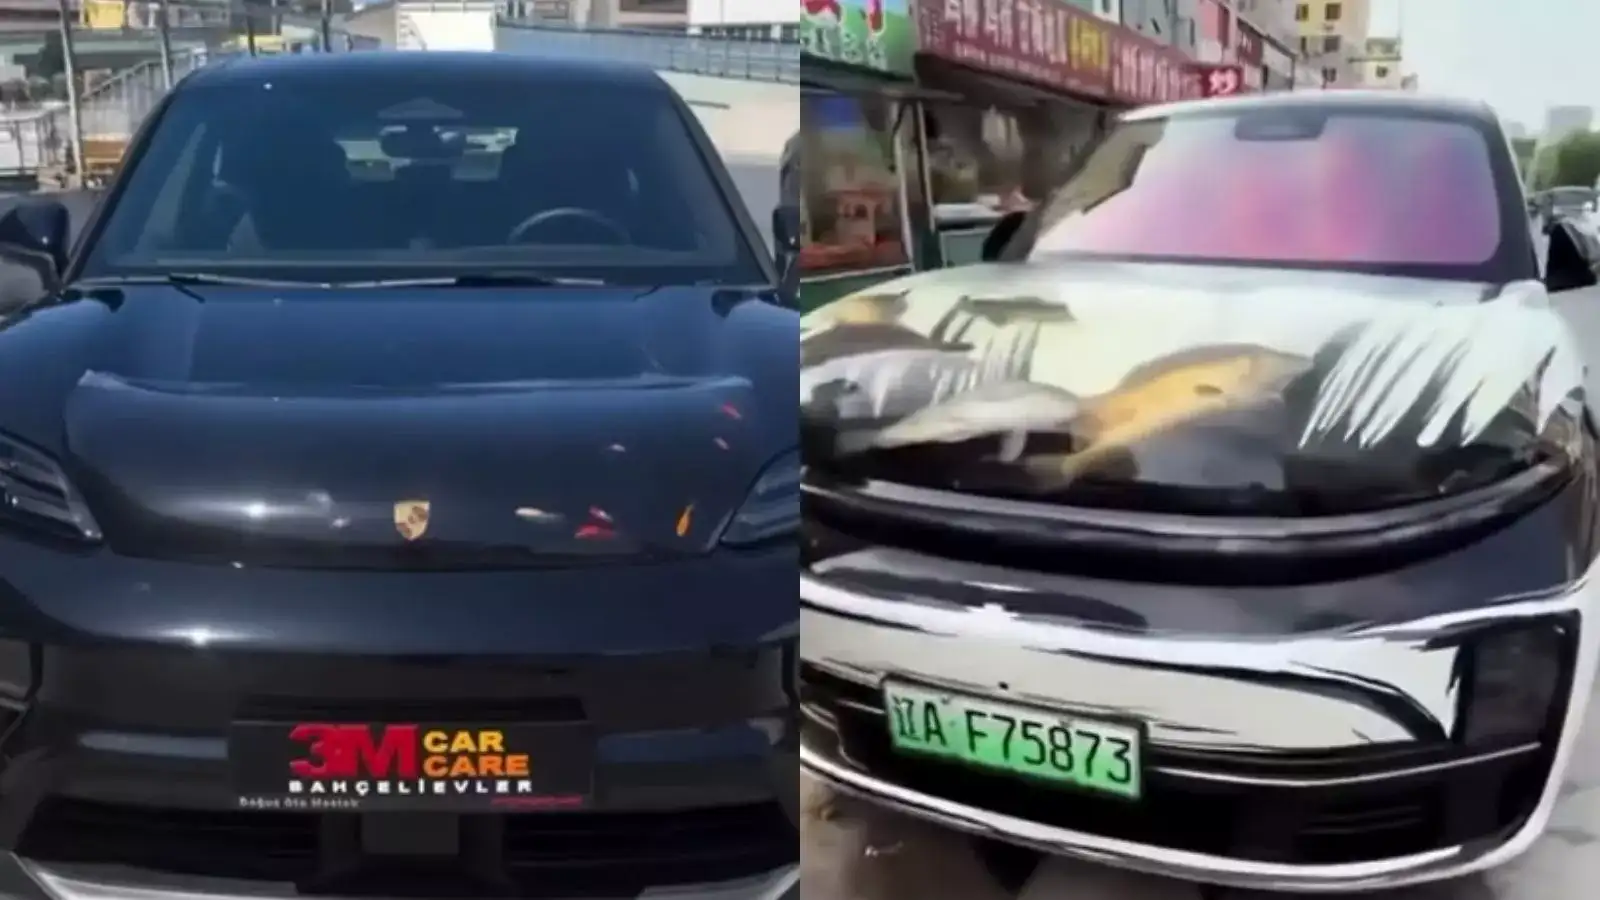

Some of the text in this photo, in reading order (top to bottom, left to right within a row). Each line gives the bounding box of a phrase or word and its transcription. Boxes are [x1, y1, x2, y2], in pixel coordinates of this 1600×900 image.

[289, 723, 418, 777] 3M
[423, 730, 504, 752] CAR
[964, 708, 1132, 784] F75873
[423, 755, 529, 777] CARE
